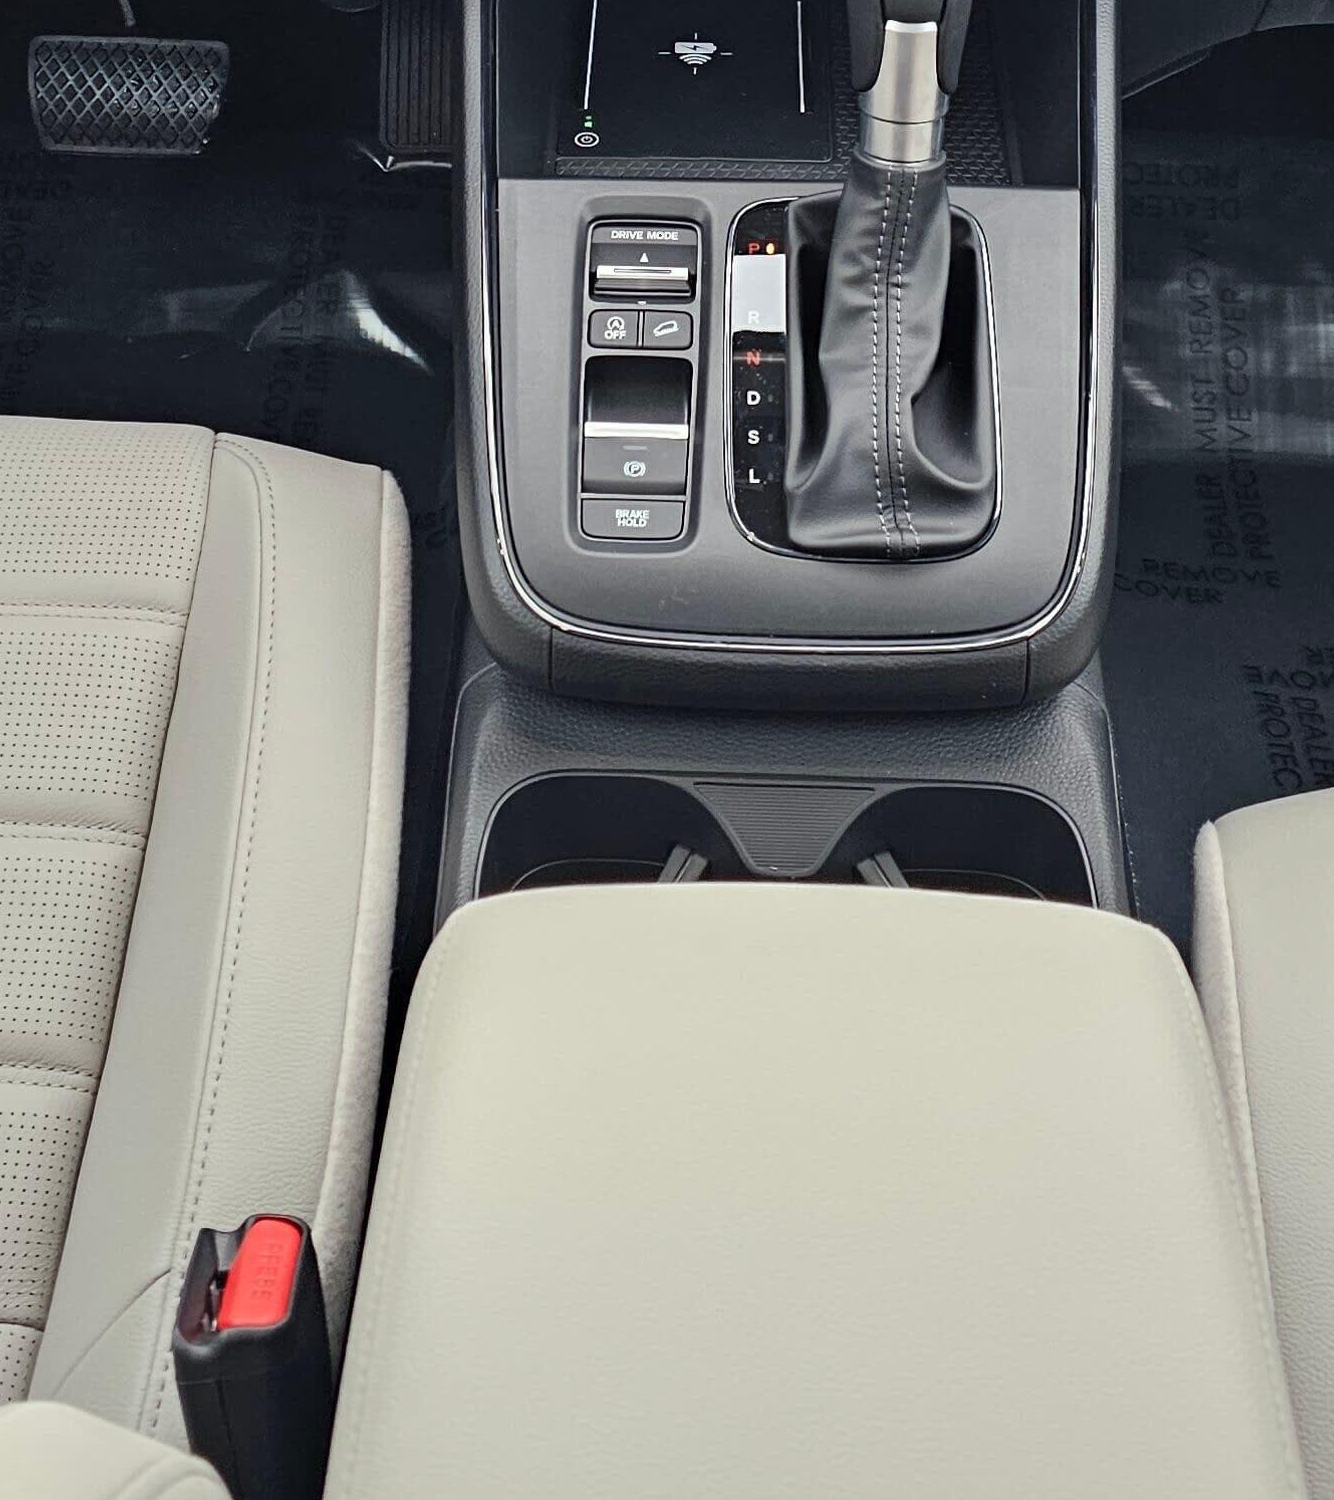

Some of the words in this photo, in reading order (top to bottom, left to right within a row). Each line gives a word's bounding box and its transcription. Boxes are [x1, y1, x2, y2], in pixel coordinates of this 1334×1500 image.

[610, 229, 643, 241] DRIVE
[646, 229, 679, 241] MODE
[748, 243, 761, 254] P
[747, 311, 760, 324] R
[603, 330, 626, 341] OFF
[1219, 285, 1251, 398] COVER
[747, 352, 761, 365] N
[747, 391, 761, 405] D
[1190, 373, 1220, 452] MUST
[748, 430, 760, 444] S
[749, 470, 761, 484] L
[1226, 407, 1275, 564] PROTECTIVE
[615, 508, 650, 519] BRAKE
[617, 517, 648, 528] HOLD
[1142, 557, 1282, 589] REMOVE
[1114, 572, 1227, 604] COVER
